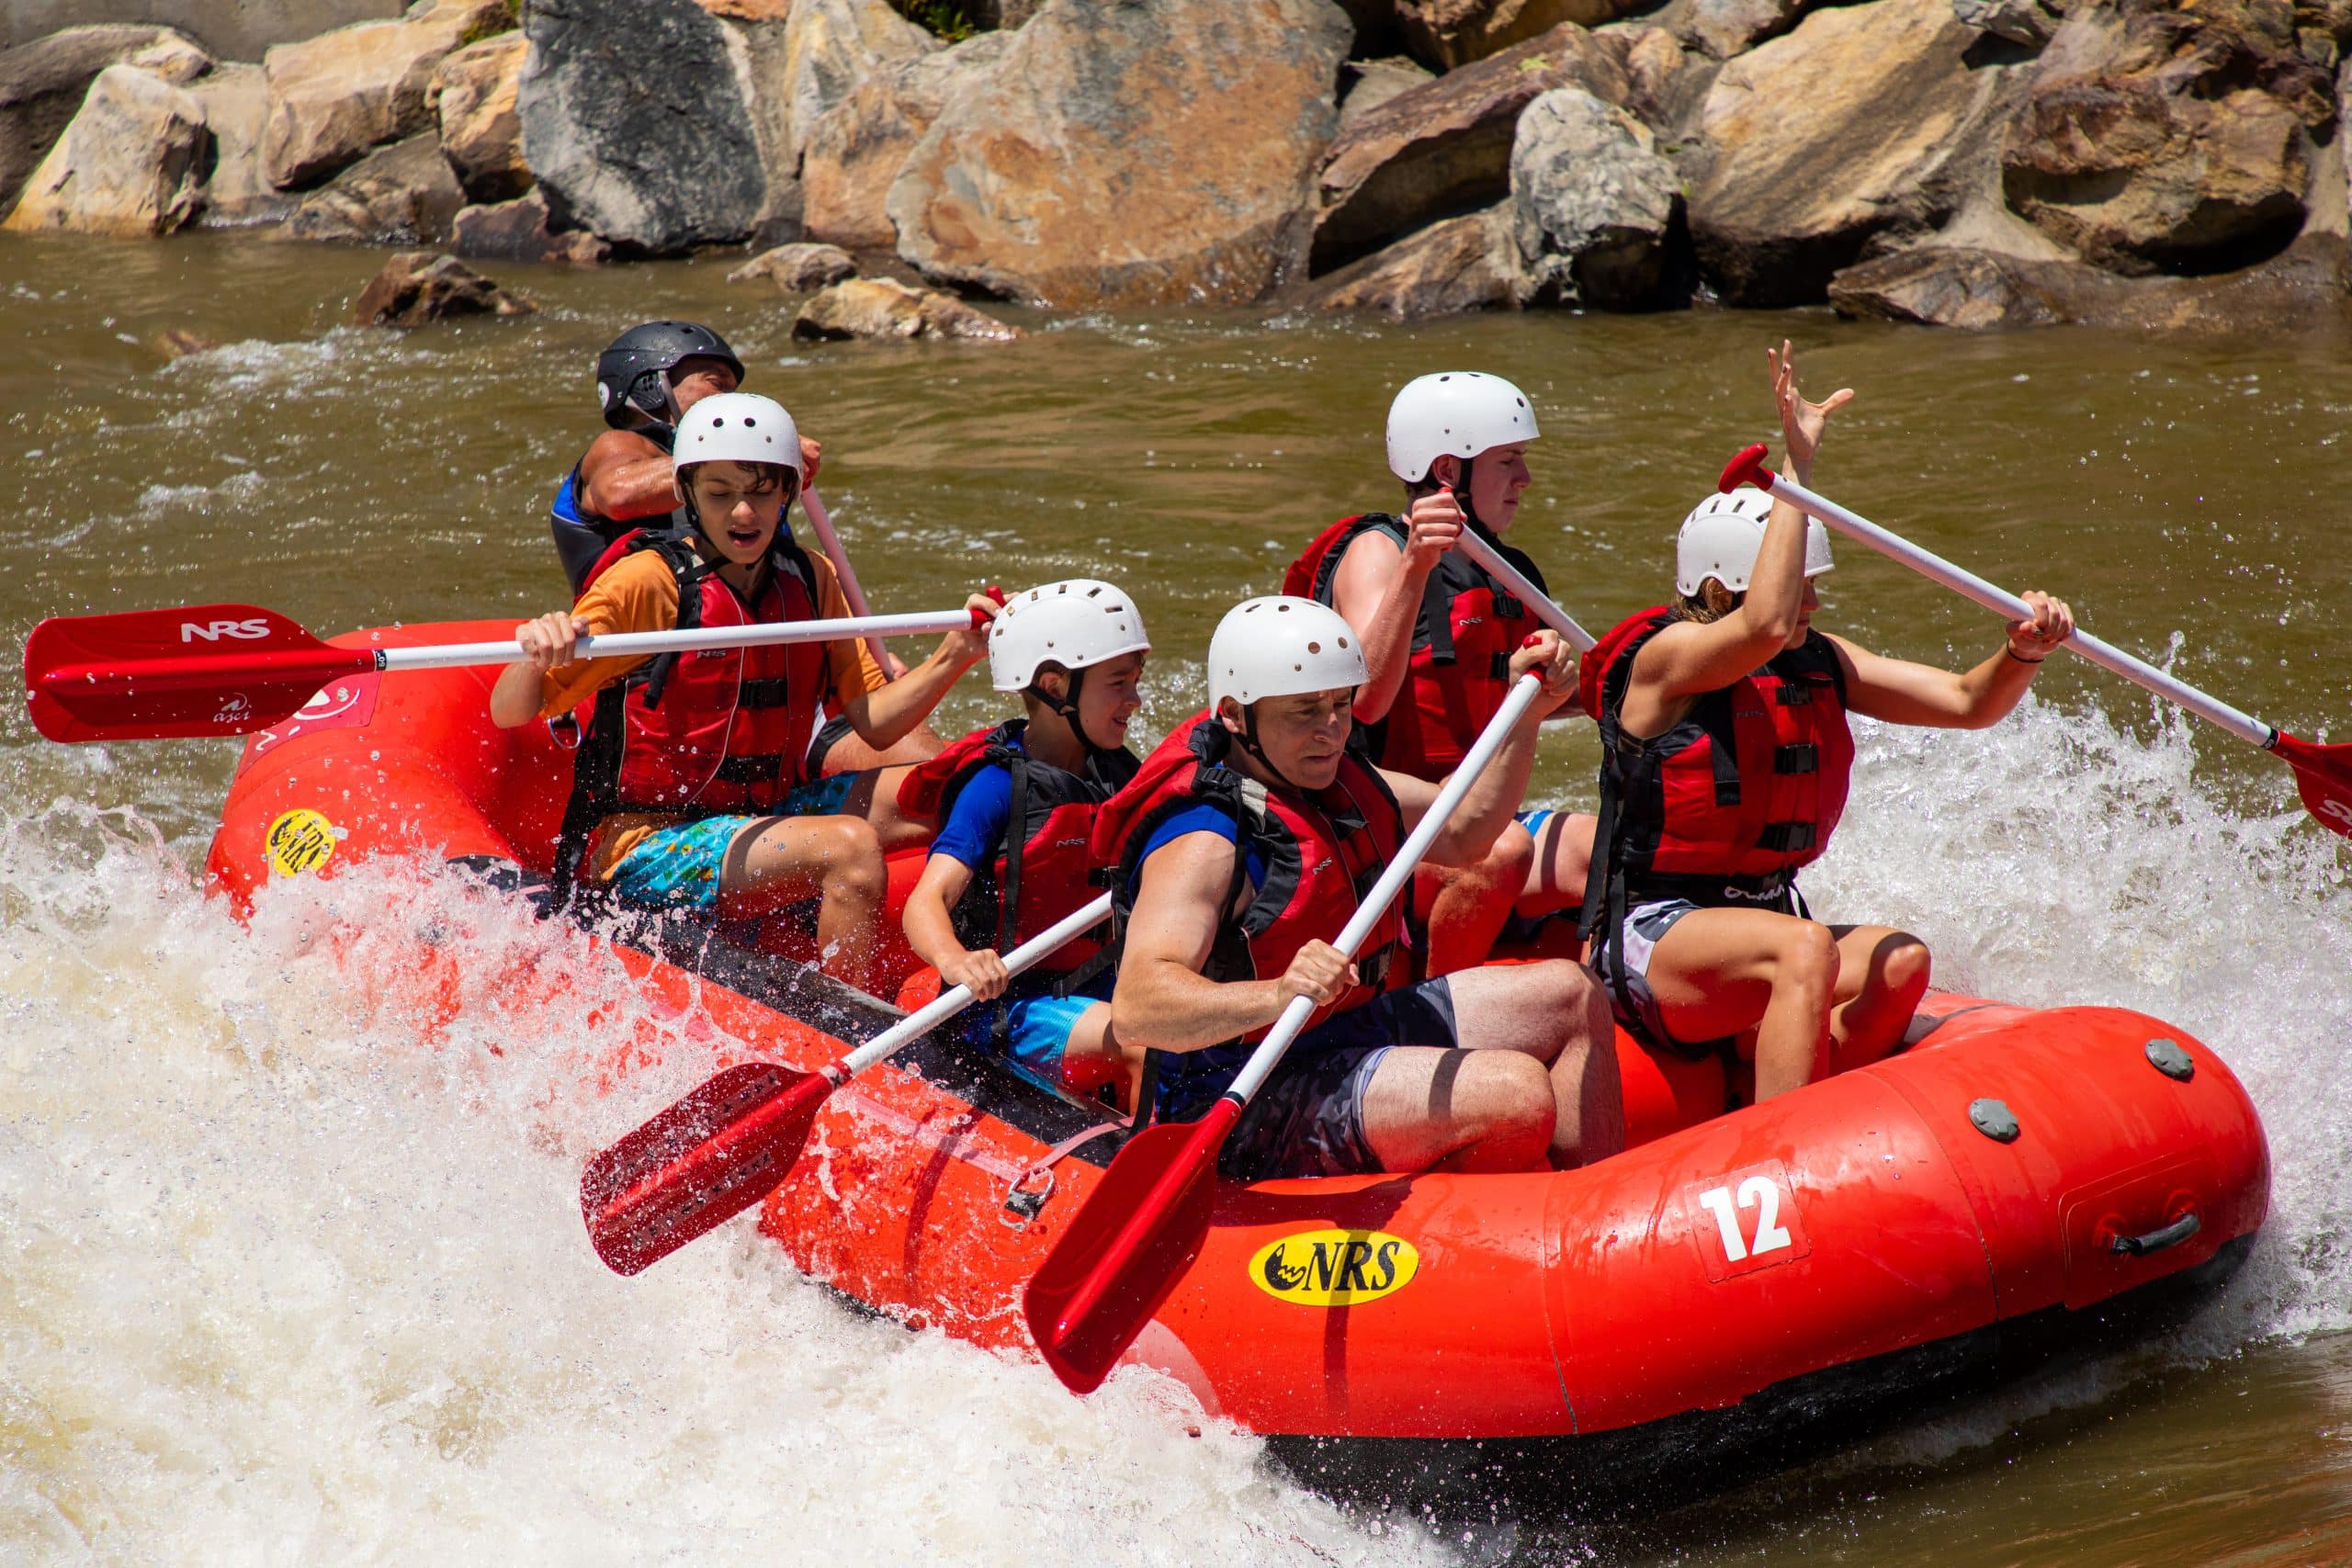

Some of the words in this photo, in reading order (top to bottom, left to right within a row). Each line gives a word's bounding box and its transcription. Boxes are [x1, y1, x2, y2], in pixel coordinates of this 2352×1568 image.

[180, 618, 271, 643] NRS
[696, 649, 727, 659] NRS
[1699, 1176, 1792, 1262] 12
[1301, 1241, 1400, 1291] NRS
